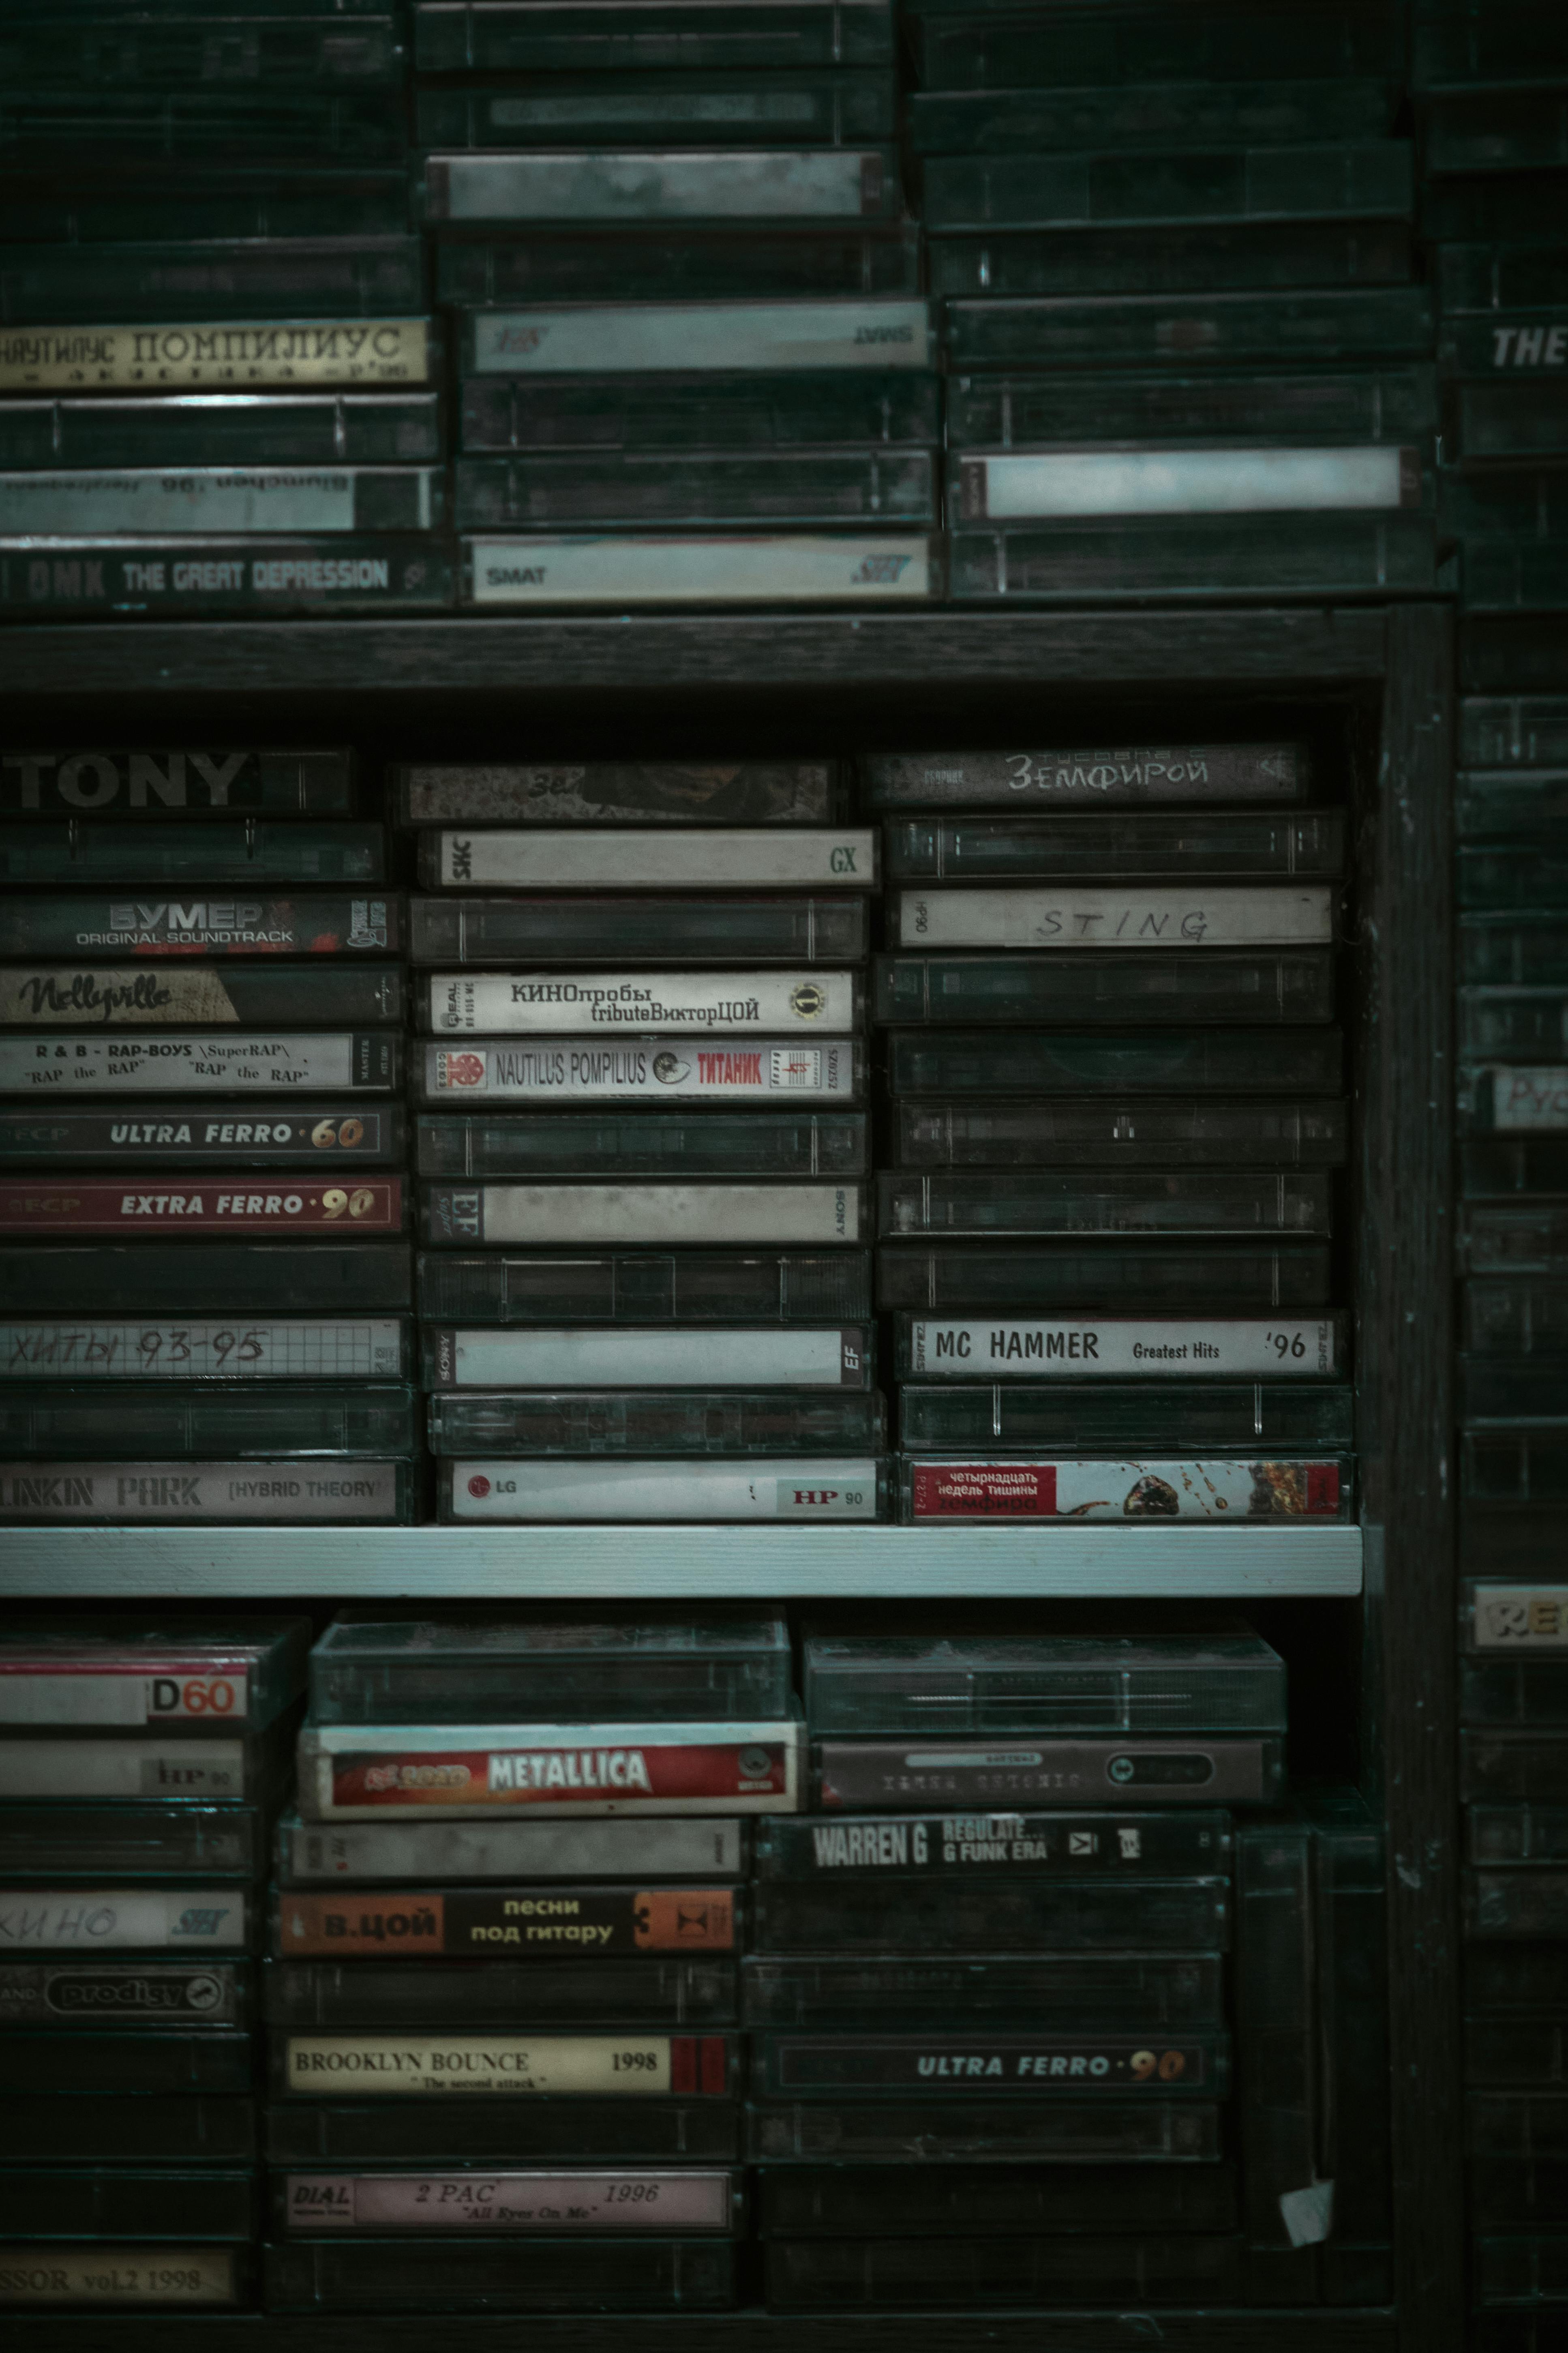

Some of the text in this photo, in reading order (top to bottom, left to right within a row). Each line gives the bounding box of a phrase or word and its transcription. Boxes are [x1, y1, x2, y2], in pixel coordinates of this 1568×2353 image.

[132, 329, 401, 363] ПОМПИЛИУС
[1492, 325, 1568, 366] THE
[27, 560, 105, 598] DMX
[122, 558, 389, 592] THE GREAT DEPRESSION
[486, 568, 546, 585] SMAT
[2, 752, 250, 808] TONY
[451, 840, 472, 880] SKC
[829, 847, 857, 873] GX
[109, 903, 263, 931] БУМЕР
[1036, 910, 1208, 942] STING
[76, 930, 293, 946] ORIGINAL SOUNDTRACK
[19, 973, 172, 1021] Nellyville
[511, 982, 652, 1006] КИНОпробы
[36, 1045, 47, 1057] R
[54, 1045, 69, 1057] &
[75, 1045, 87, 1057] B
[108, 1044, 192, 1057] RAP-BOYS
[74, 1067, 96, 1079] the
[237, 1063, 260, 1079] the
[495, 1051, 647, 1086] NAUTILUS POMPILIUS
[697, 1052, 762, 1085] ТИТАНИК
[110, 1124, 193, 1145] ULTRA
[311, 1118, 364, 1149] 60
[120, 1194, 204, 1215] EXTRA
[321, 1188, 376, 1219] 90
[836, 1190, 846, 1235] SONY
[11, 1330, 269, 1366] ХИТЫ 93-95
[844, 1345, 860, 1371] EF
[935, 1331, 972, 1359] MC
[990, 1330, 1099, 1360] HAMMER
[1132, 1343, 1188, 1361] Greatest
[1193, 1342, 1221, 1360] Hits
[117, 1477, 202, 1506] PARK
[306, 1480, 375, 1498] THEORY
[496, 1480, 517, 1493] LG
[938, 1484, 1038, 1497] недель тишины
[950, 1472, 1038, 1485] четырнадцать
[792, 1490, 863, 1506] HP 90
[1486, 1600, 1568, 1637] RE
[153, 1677, 236, 1714] D60
[486, 1748, 654, 1795] METALLICA
[813, 1823, 929, 1867] WARREN G
[943, 1840, 1048, 1863] G FUNK ERA
[503, 1898, 581, 1917] песни
[469, 1924, 614, 1947] под гитару
[62, 1980, 184, 2008] prodigy
[295, 2052, 658, 2072] BROOKLYN BOUNCE 1998
[917, 2056, 1004, 2076] ULTRA
[1129, 2050, 1187, 2081] 90
[450, 2076, 493, 2089] second
[496, 2076, 536, 2089] attack
[293, 2186, 350, 2204] DIAL
[415, 2184, 660, 2203] 2 PAC 1996
[538, 2206, 561, 2219] On
[148, 2268, 202, 2291] 1998
